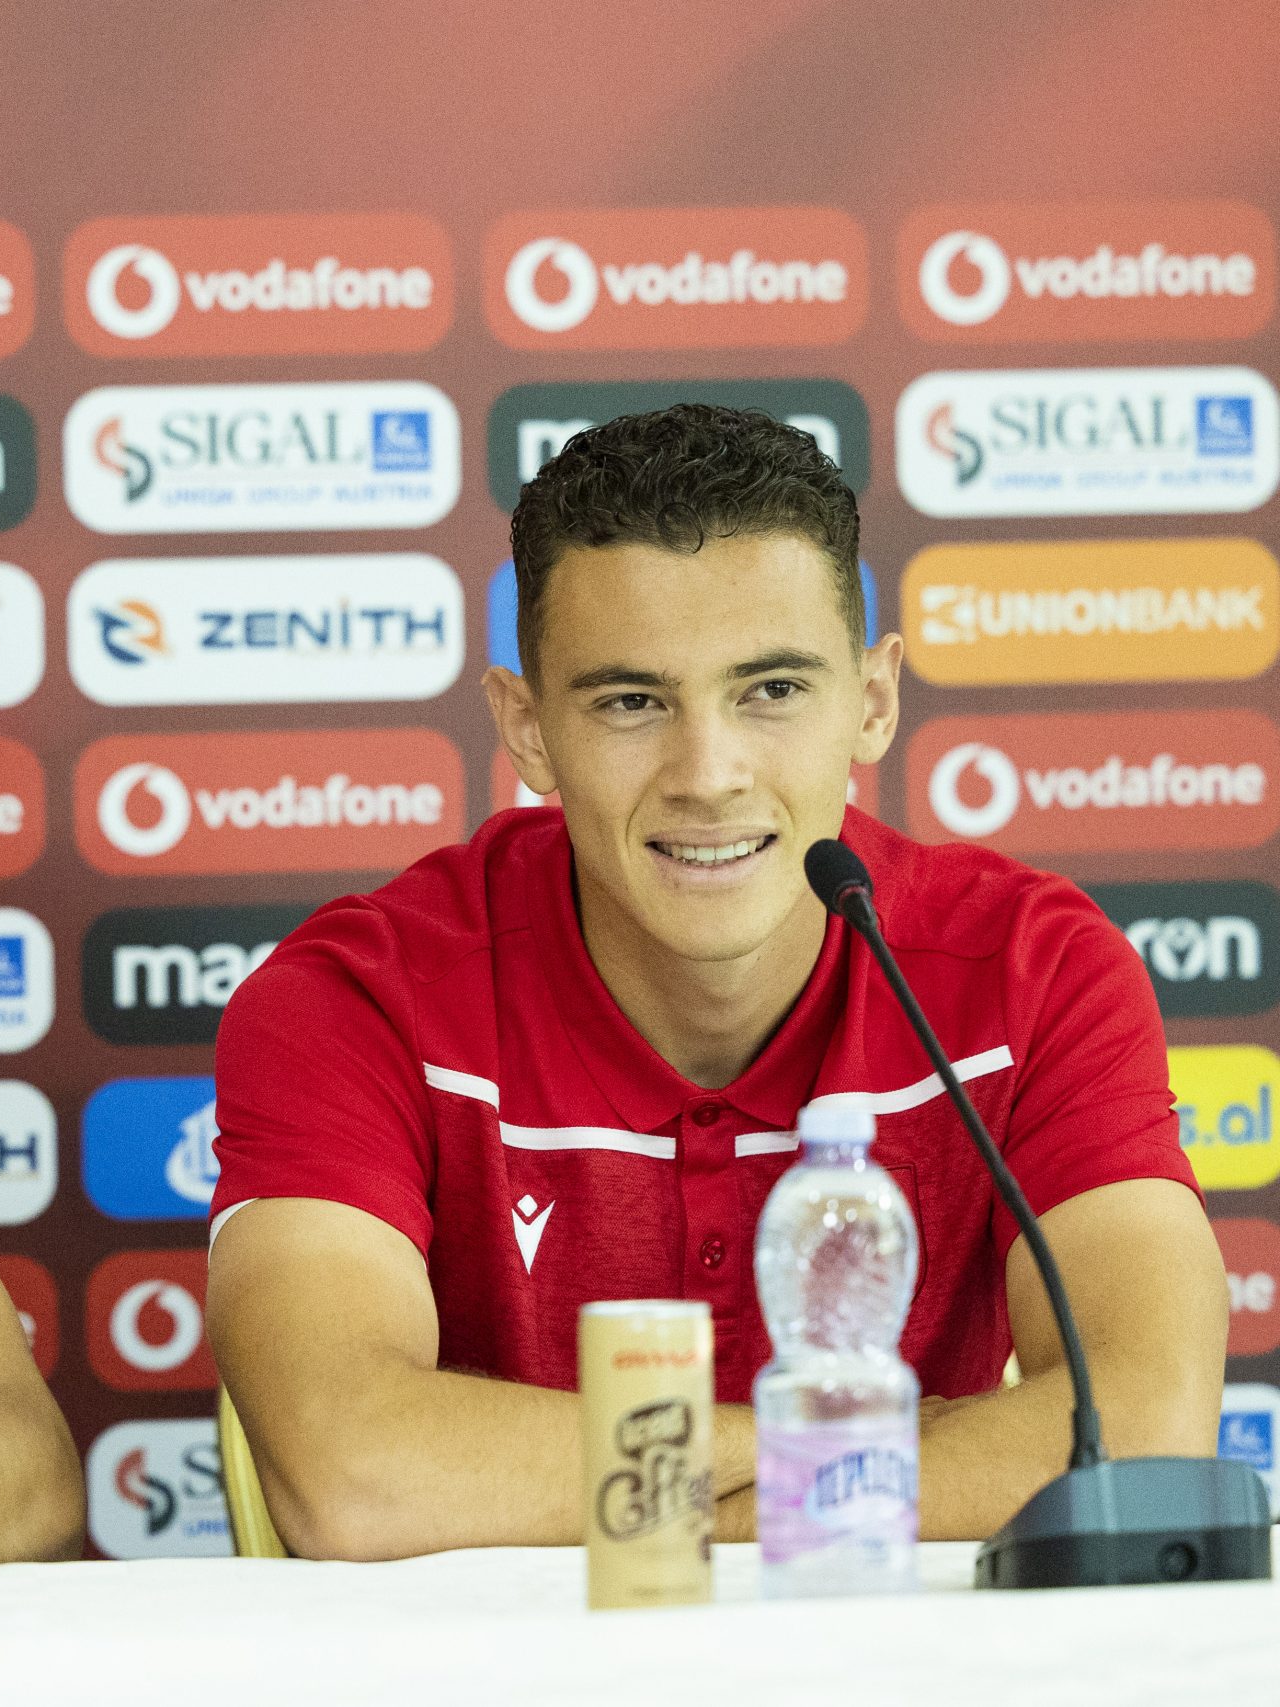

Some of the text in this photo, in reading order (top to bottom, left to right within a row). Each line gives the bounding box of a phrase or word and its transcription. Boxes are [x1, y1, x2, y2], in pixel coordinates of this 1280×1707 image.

[186, 258, 432, 311] vodafone
[603, 251, 847, 304] vodafone
[1018, 244, 1255, 298] vodafone
[159, 409, 366, 468] SIGAL
[987, 394, 1192, 452] SIGAL
[977, 589, 1263, 635] UNIONBANK
[196, 774, 442, 828] vodafone
[1025, 755, 1265, 808] vodafone
[1125, 917, 1261, 981] ron
